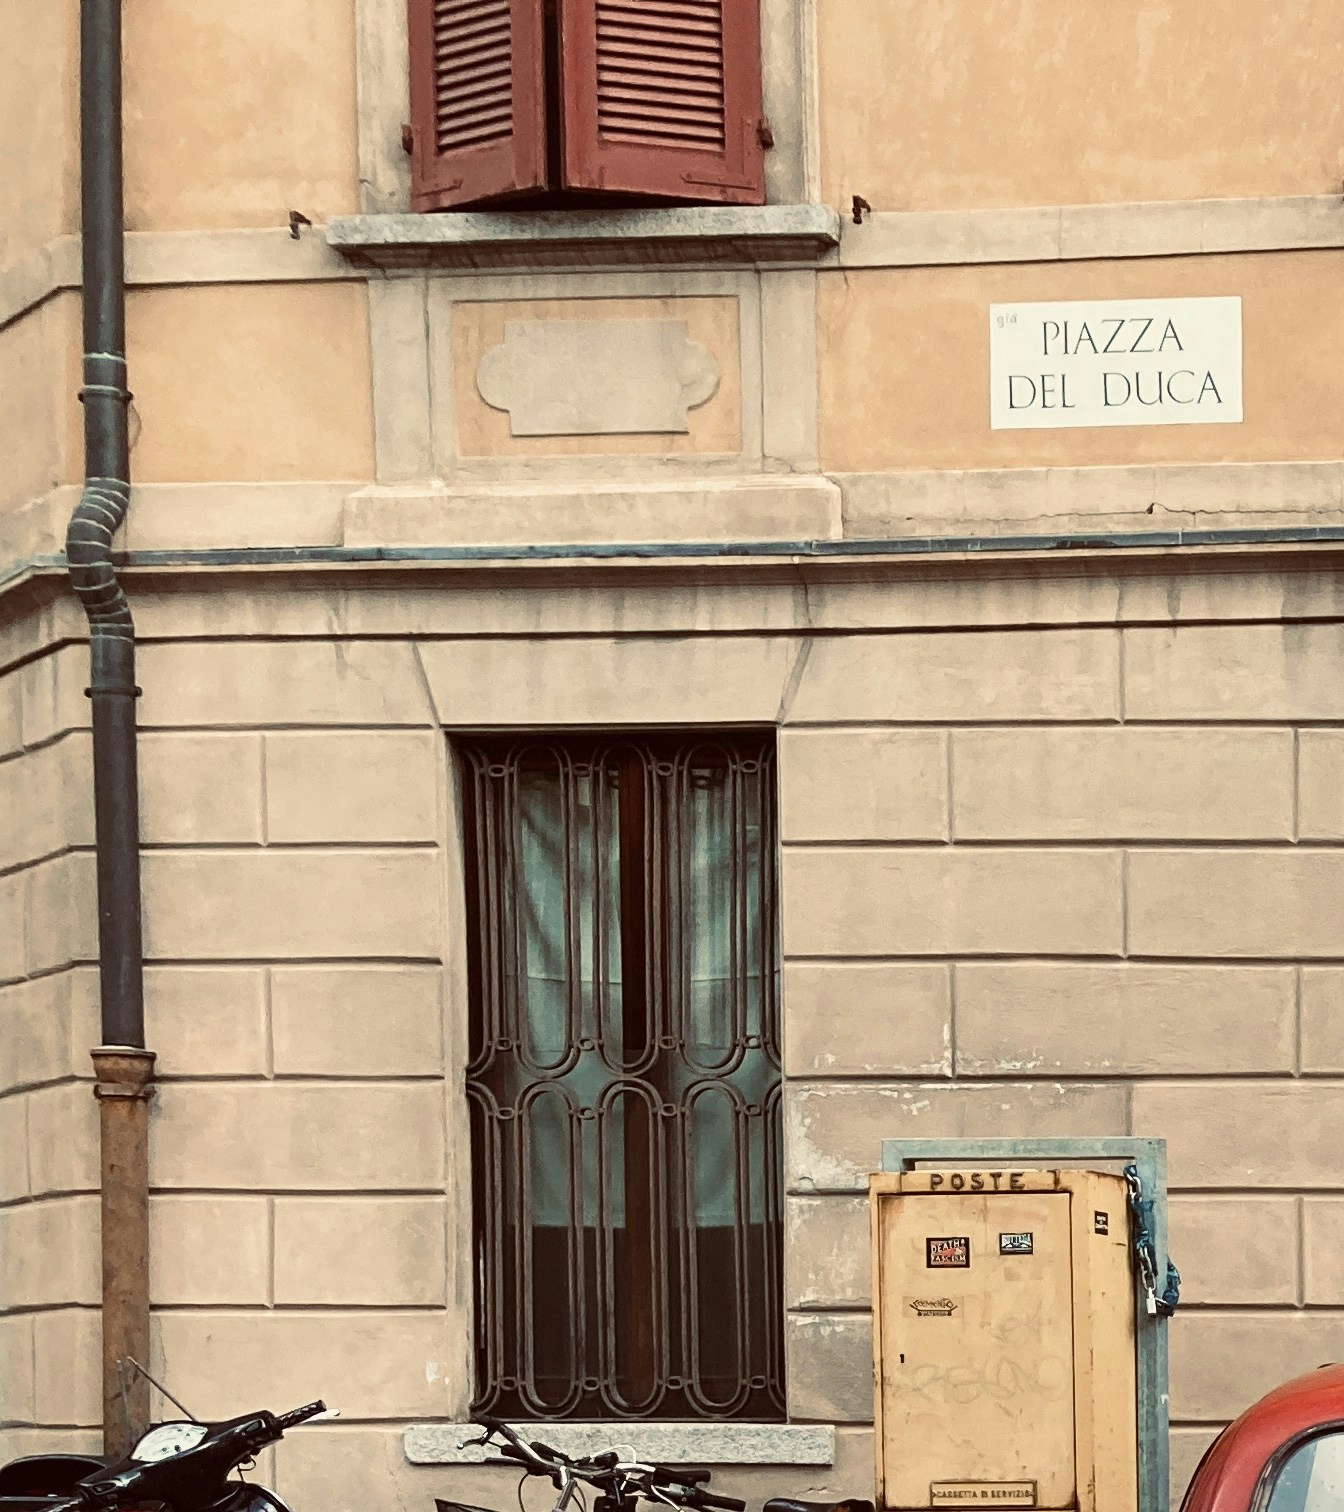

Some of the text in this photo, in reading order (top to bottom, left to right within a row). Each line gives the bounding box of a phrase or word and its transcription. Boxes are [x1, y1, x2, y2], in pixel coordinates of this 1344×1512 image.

[1042, 317, 1184, 356] PIAZZA
[1008, 370, 1223, 409] DEL DUCA
[930, 1172, 1026, 1190] POSTE
[931, 1239, 960, 1254] DEATH
[936, 1490, 978, 1499] CASSETTA
[991, 1489, 1030, 1498] SERVIZIO
